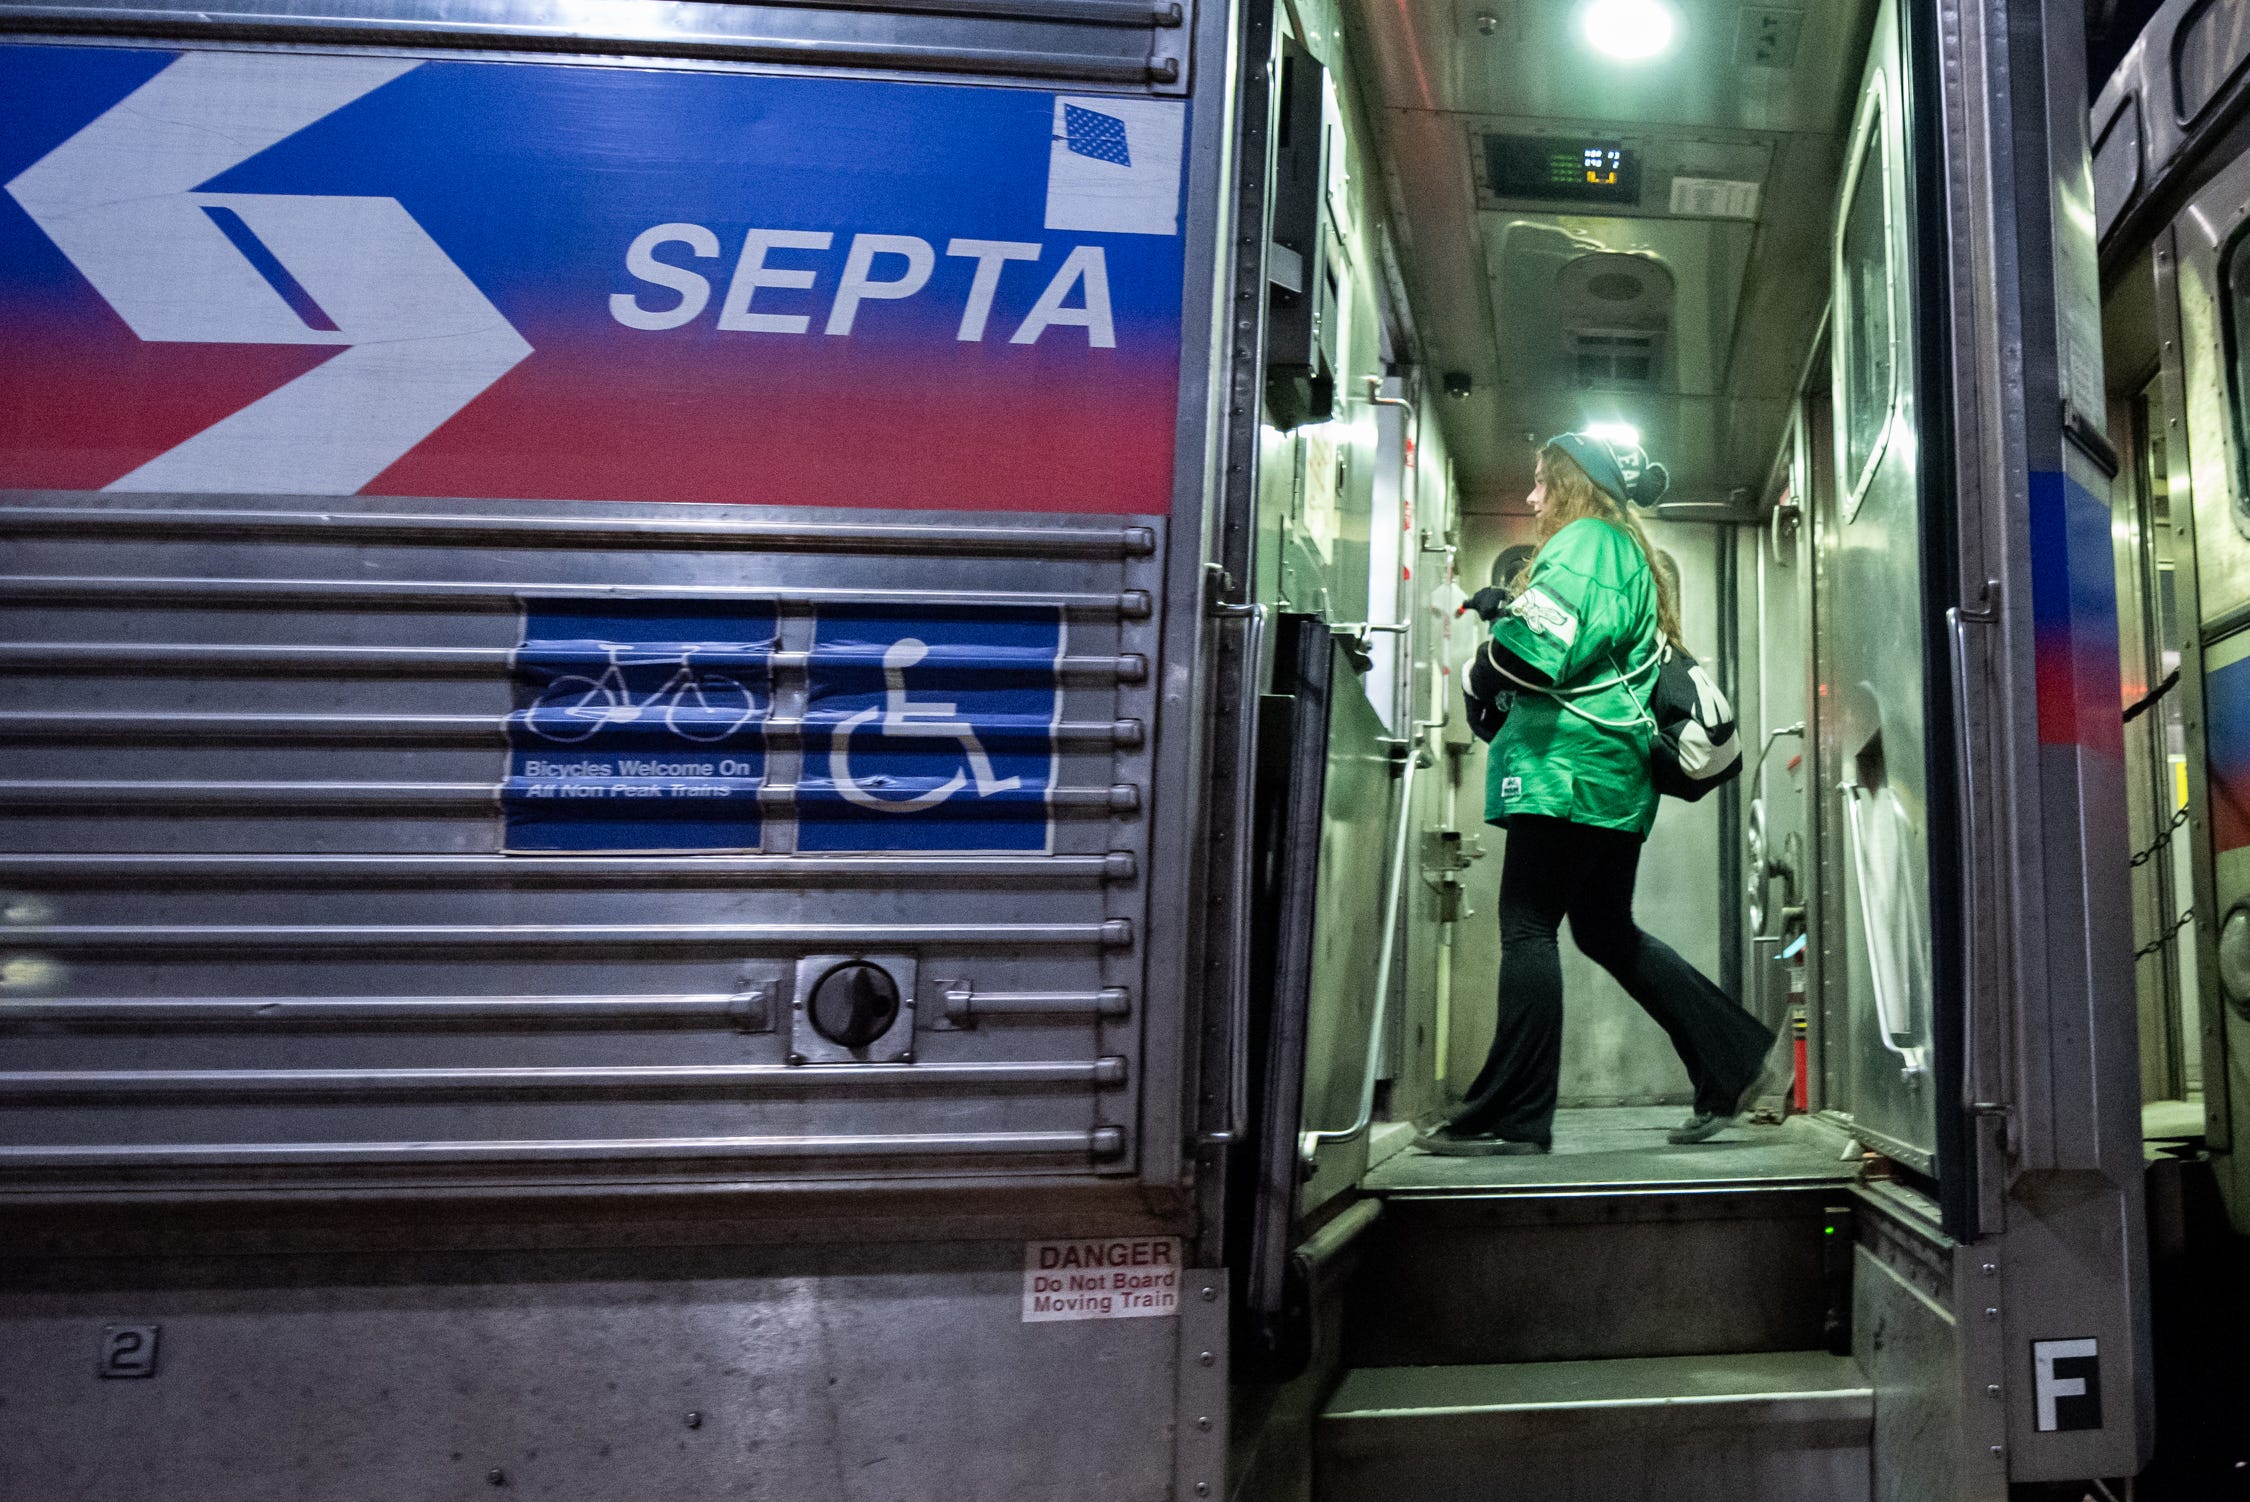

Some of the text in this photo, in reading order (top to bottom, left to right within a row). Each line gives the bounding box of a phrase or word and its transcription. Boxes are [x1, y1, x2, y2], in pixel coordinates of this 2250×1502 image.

[609, 222, 1116, 348] SEPTA
[525, 759, 750, 779] Bicycles Welcome On
[526, 783, 732, 798] All Non Peak Trains
[1040, 1242, 1172, 1269] DANGER
[1034, 1272, 1175, 1292] Do Not Board
[1034, 1291, 1175, 1313] Moving Train
[110, 1331, 142, 1370] 2
[2034, 1338, 2098, 1431] F
